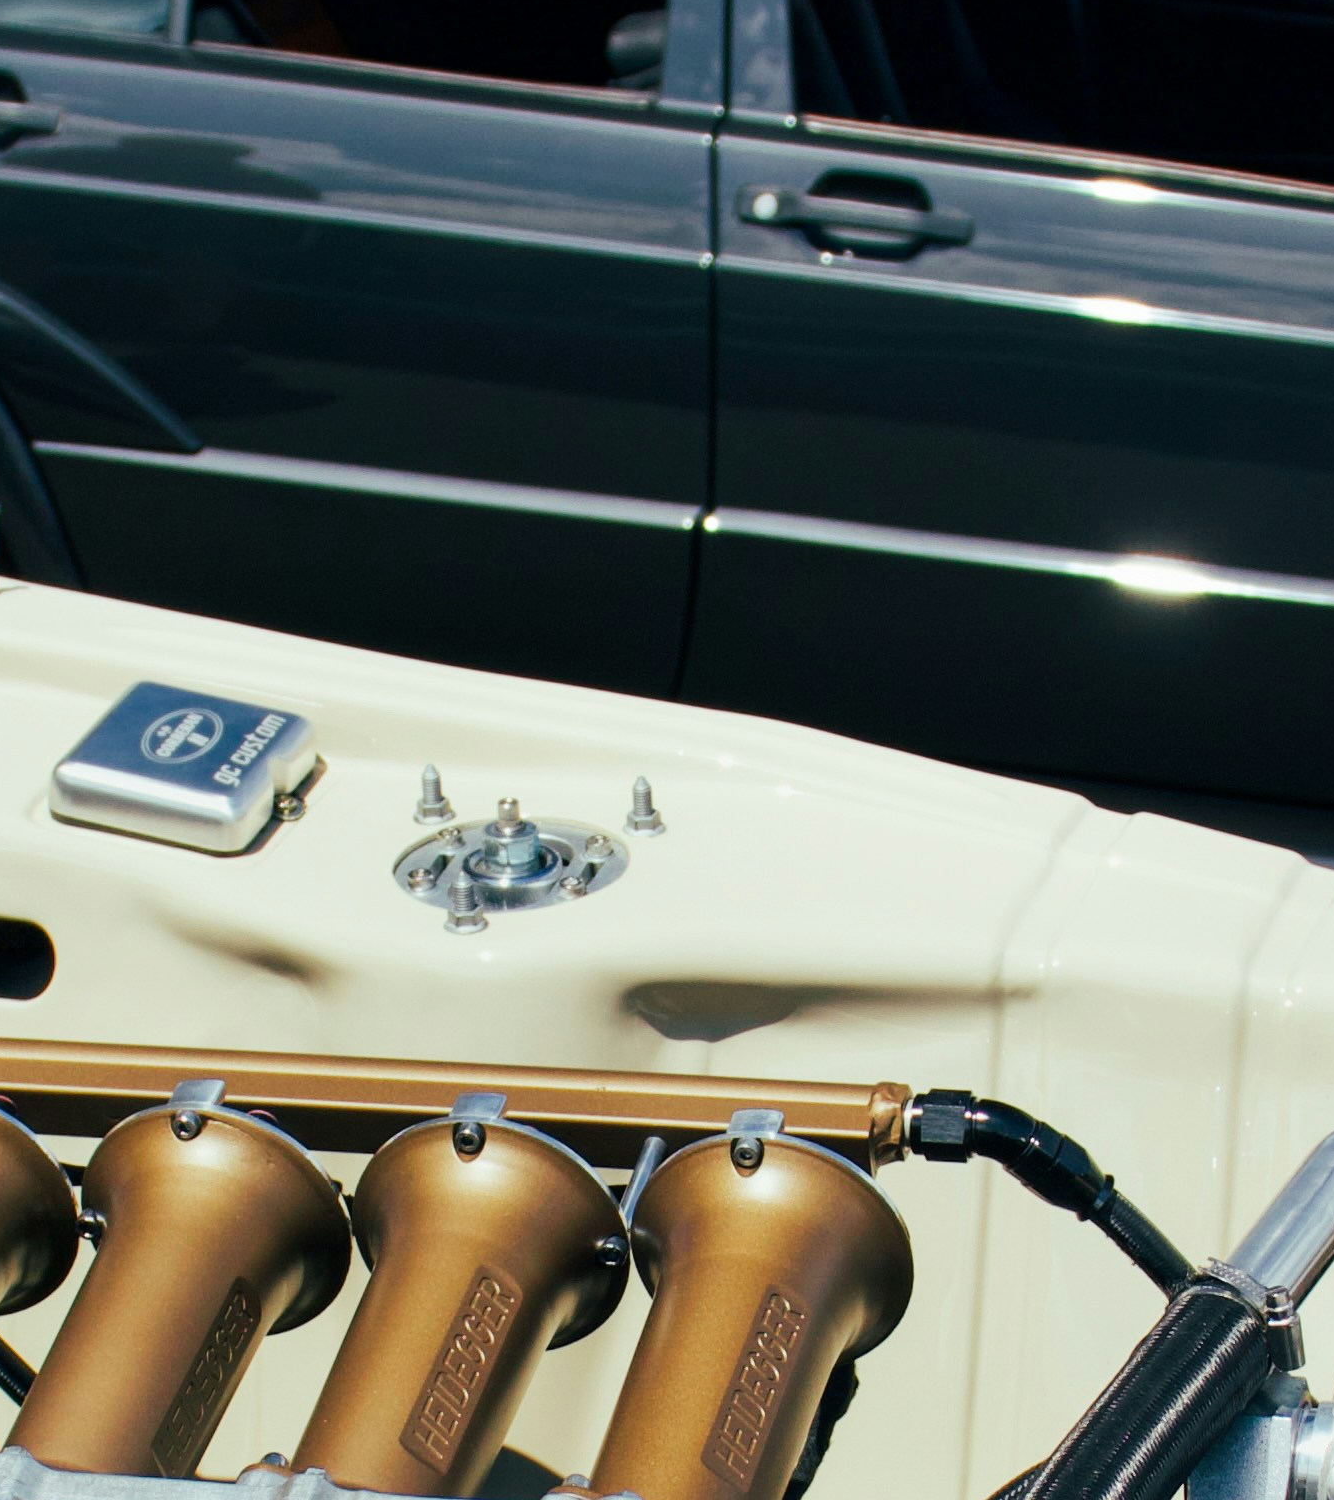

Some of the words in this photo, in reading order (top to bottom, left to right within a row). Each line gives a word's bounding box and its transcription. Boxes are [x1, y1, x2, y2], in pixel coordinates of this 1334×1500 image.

[213, 763, 242, 788] gc
[230, 713, 288, 767] custom
[410, 1275, 516, 1461] HEIDEGGER
[714, 1292, 806, 1480] HEIDEGGER
